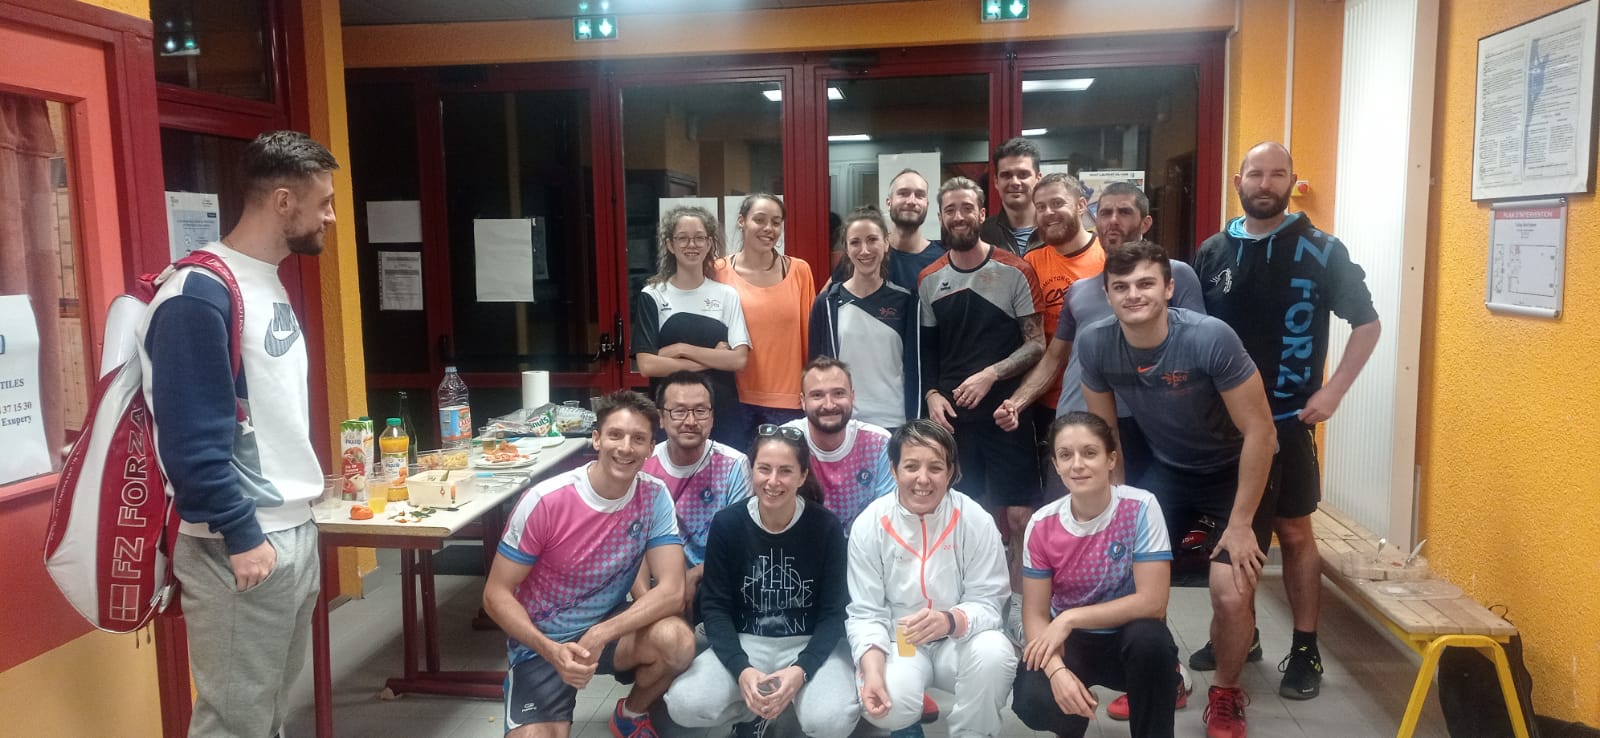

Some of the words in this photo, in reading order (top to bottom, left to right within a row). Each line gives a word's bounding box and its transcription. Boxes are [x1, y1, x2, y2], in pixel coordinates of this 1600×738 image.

[117, 407, 149, 528] FORZA
[112, 536, 145, 579] FZ
[758, 547, 796, 590] THE
